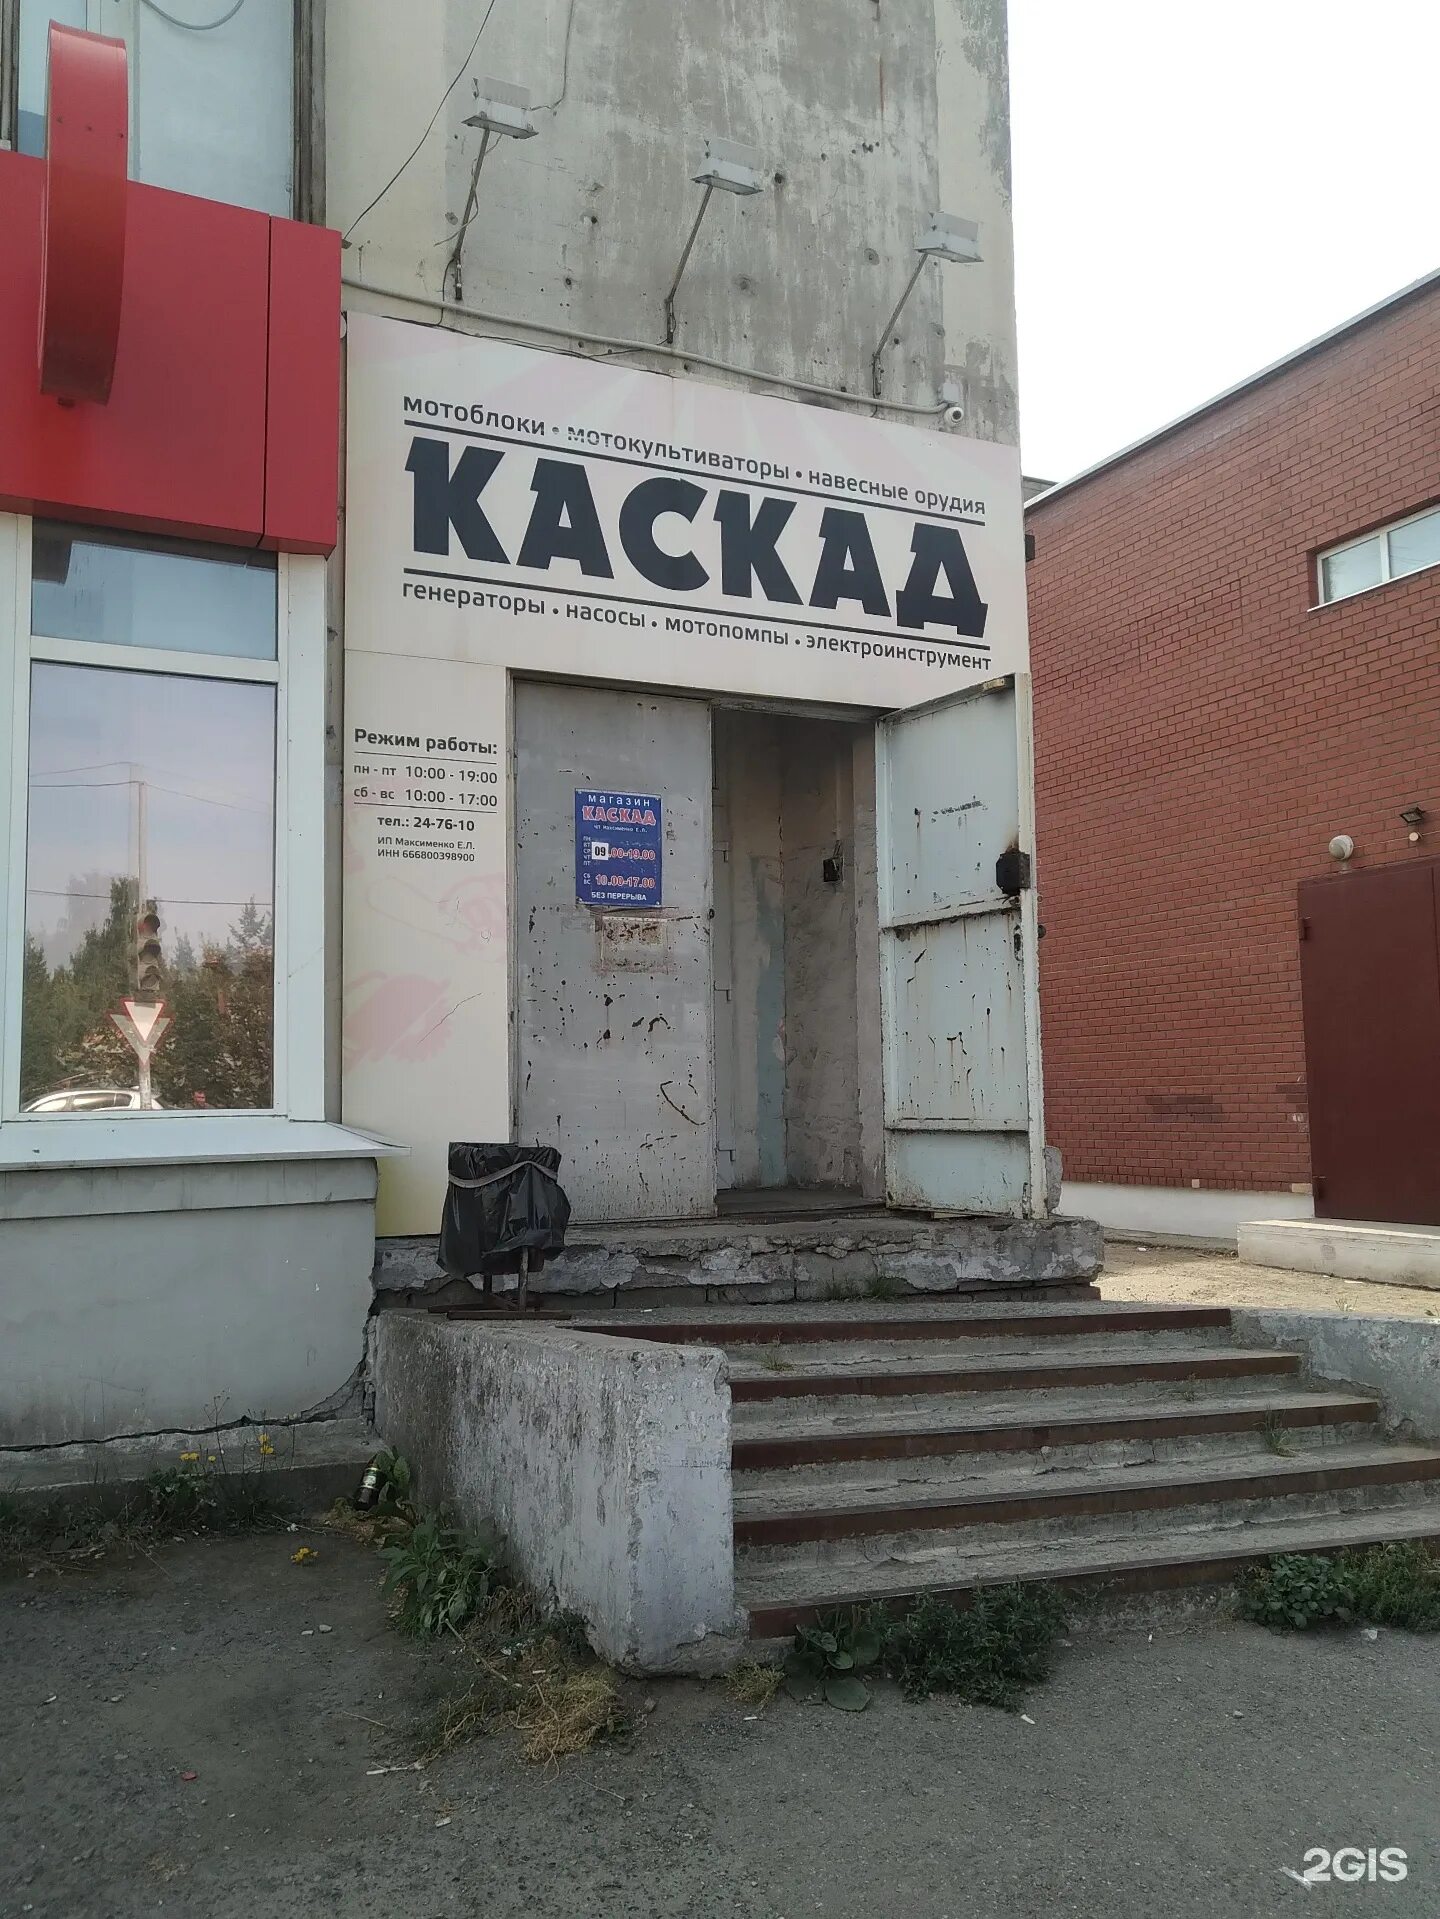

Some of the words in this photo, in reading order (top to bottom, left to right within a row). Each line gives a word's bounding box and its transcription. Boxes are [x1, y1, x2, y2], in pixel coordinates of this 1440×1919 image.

[403, 396, 545, 436] мотоблоки
[567, 426, 790, 480] мотокультиваторы
[808, 469, 909, 501] навесные
[914, 488, 986, 516] орудия
[404, 436, 989, 638] КАСКАД
[402, 582, 545, 616] генераторы
[566, 604, 645, 628] насосы
[665, 617, 788, 646] мотопомпы
[806, 634, 992, 671] электроинструмент
[354, 728, 420, 748] Режим
[426, 737, 498, 755] работы:
[353, 765, 370, 774] пн
[382, 767, 397, 776] пт
[405, 765, 446, 780] 10:00
[459, 770, 498, 784] 19:00
[353, 787, 368, 798] сб
[380, 790, 395, 800] вс
[405, 789, 446, 803] 10:00
[459, 793, 498, 807] 17:00
[588, 794, 650, 807] магазин
[377, 816, 410, 828] тел.:
[413, 816, 475, 831] 24-76-10
[582, 805, 656, 826] КАСКАД
[377, 836, 393, 846] ИП
[395, 837, 455, 849] Максименко
[457, 841, 475, 850] Е.Л.
[377, 849, 400, 858] ИНН
[595, 874, 655, 888] 10.00-17.00
[591, 891, 606, 899] БЕЗ
[606, 892, 647, 901] ПЕРЕРЫВА
